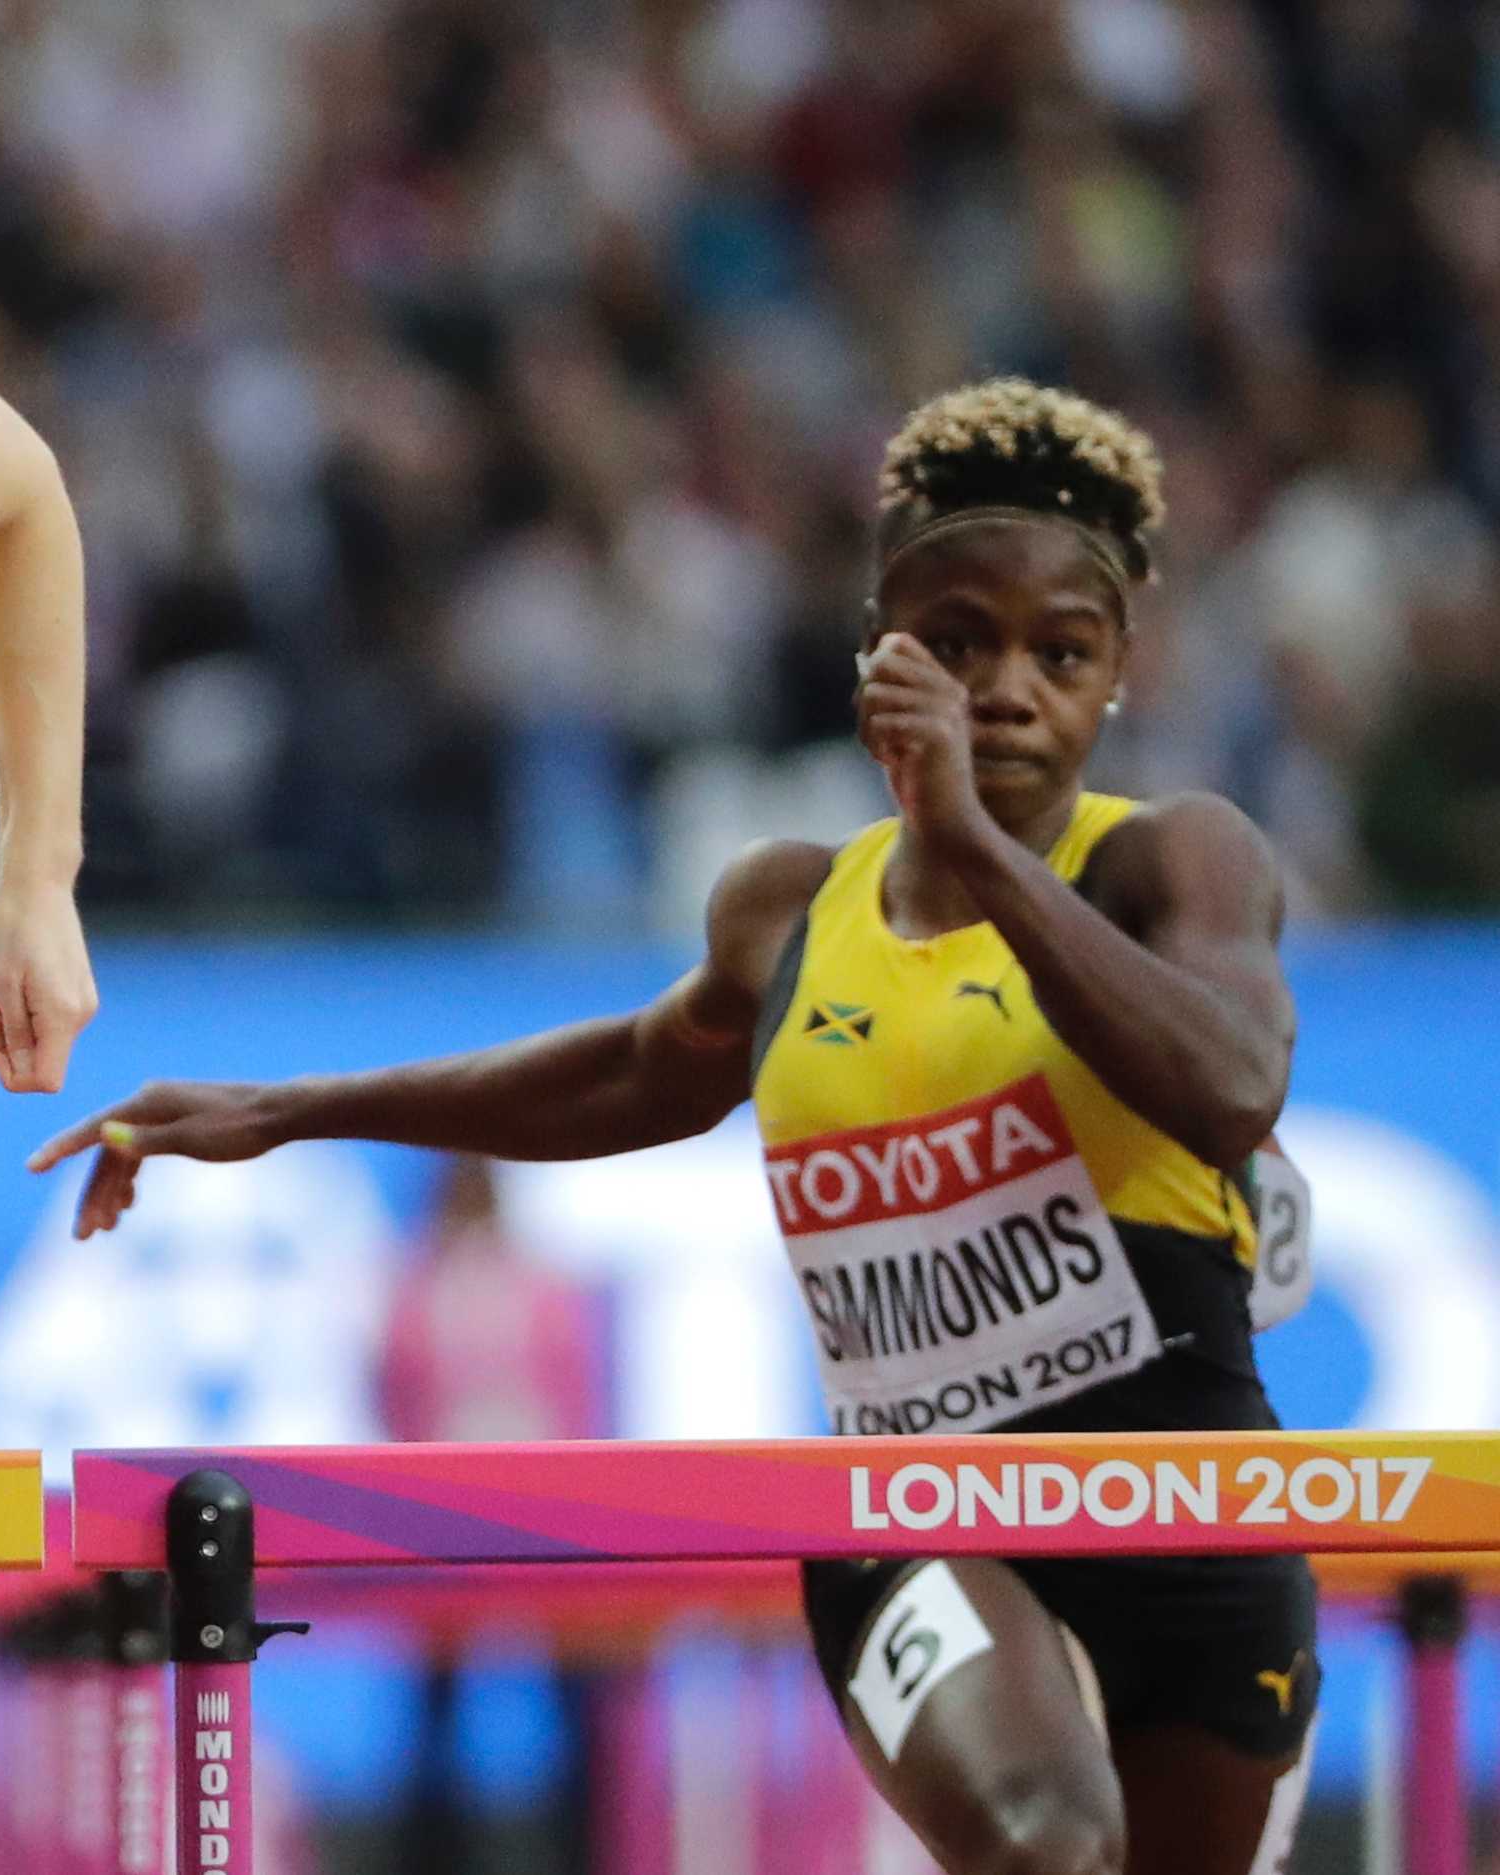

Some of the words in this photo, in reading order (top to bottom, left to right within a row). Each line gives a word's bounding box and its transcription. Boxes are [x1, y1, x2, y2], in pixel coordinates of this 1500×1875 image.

[766, 1101, 1055, 1226] TOYOTA
[802, 1193, 1104, 1362] SIMMONDS
[1022, 1314, 1133, 1391] 2017
[848, 1461, 1219, 1530] LONDON
[1235, 1456, 1434, 1525] 2017
[883, 1604, 942, 1700] 5
[195, 1730, 233, 1875] MOND
